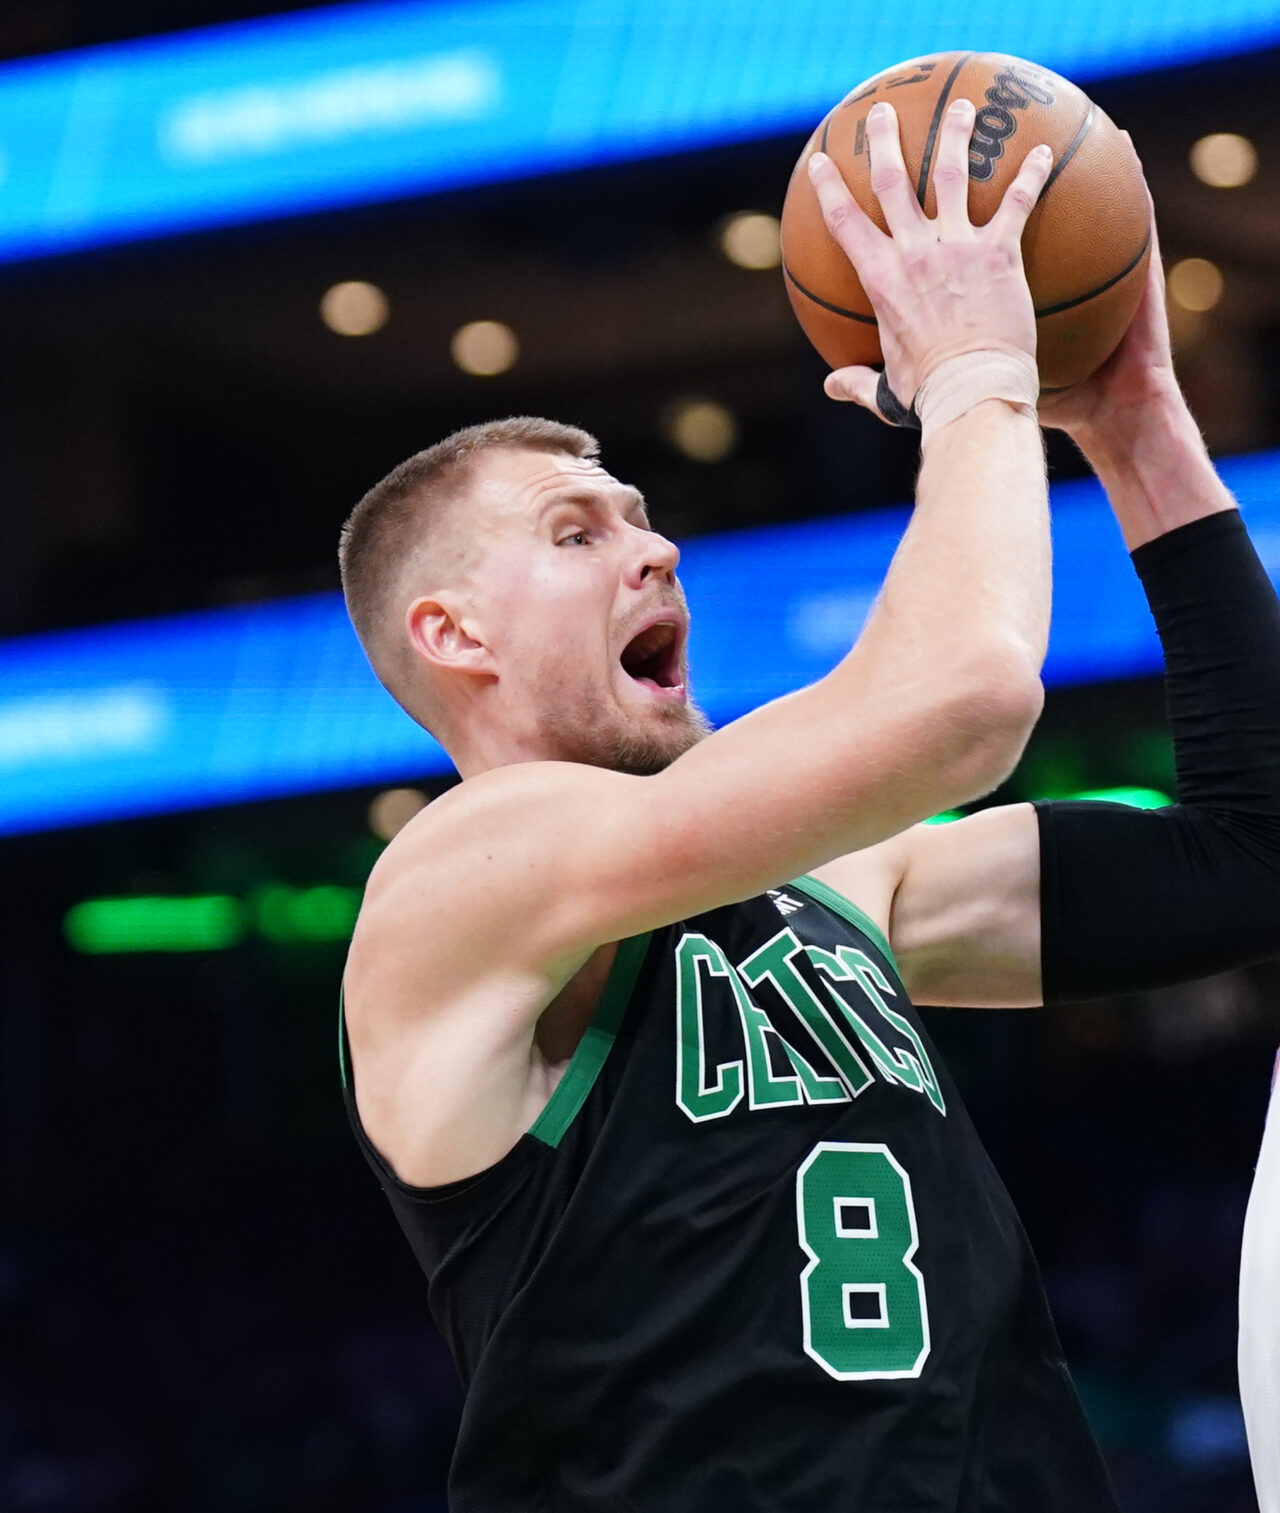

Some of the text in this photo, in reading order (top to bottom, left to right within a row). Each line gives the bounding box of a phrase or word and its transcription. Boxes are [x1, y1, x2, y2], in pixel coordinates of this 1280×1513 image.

[968, 65, 1056, 182] lson
[676, 926, 947, 1124] CELTCS
[796, 1141, 931, 1381] 8
